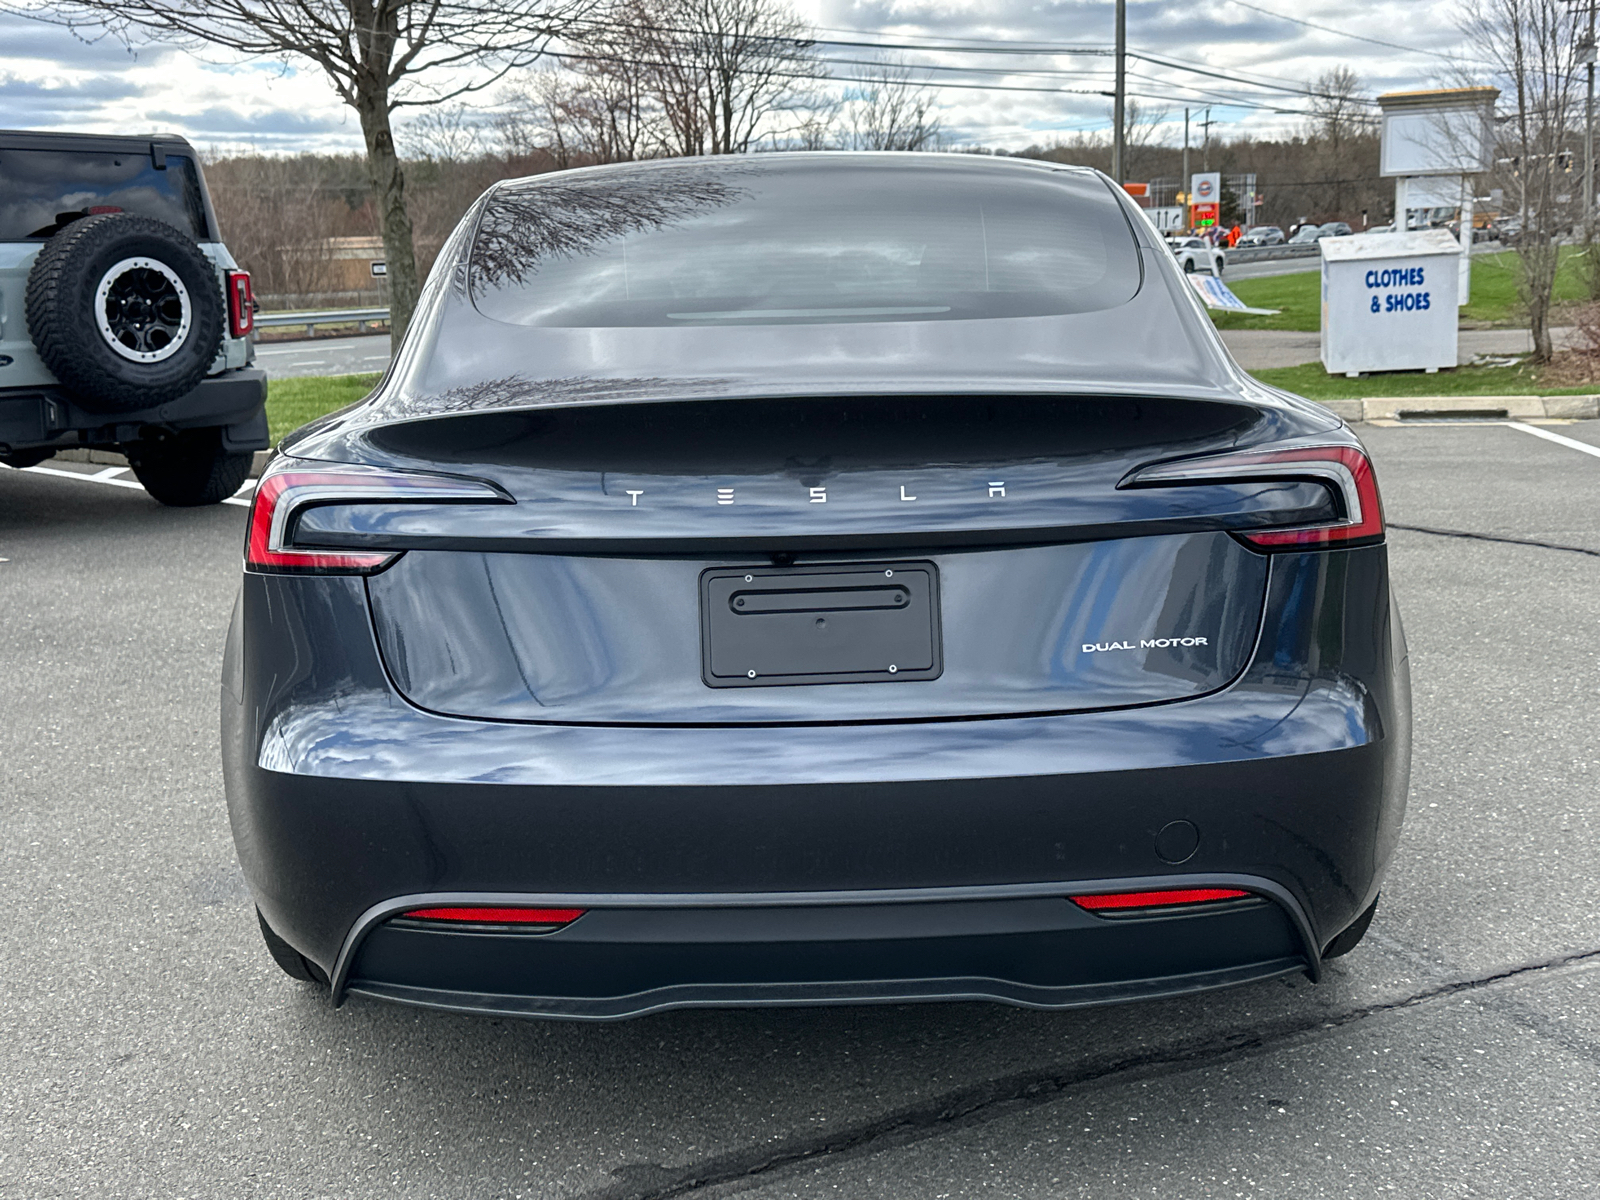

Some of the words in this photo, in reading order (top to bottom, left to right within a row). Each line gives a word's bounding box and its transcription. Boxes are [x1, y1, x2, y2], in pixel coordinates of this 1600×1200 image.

[1365, 267, 1425, 289] CLOTHES
[1370, 295, 1381, 313] &
[1385, 292, 1431, 312] SHOES
[625, 481, 1006, 507] TESLA
[1081, 640, 1136, 654] DUAL
[1139, 636, 1208, 650] MOTOR
